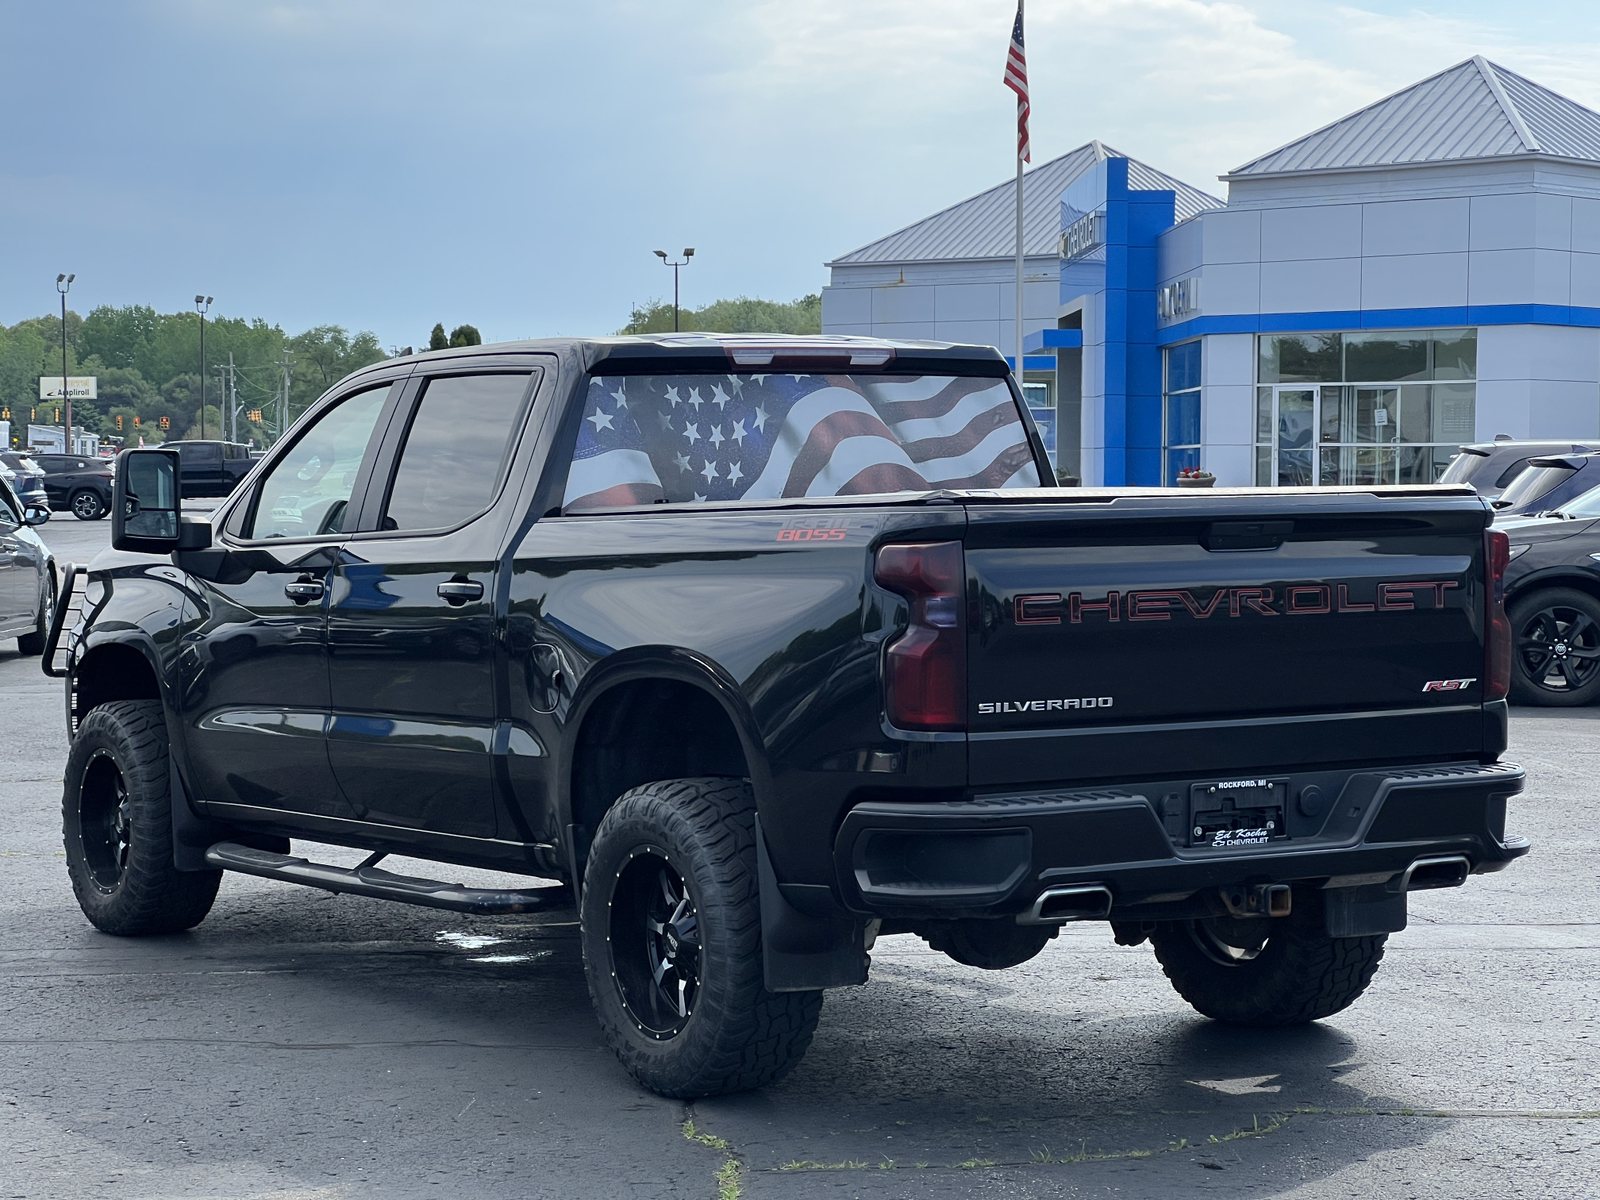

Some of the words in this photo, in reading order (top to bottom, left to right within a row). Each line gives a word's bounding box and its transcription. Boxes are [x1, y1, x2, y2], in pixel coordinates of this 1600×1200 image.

[776, 528, 848, 541] BOSS
[1013, 580, 1459, 626] CHEVROLET
[1421, 677, 1477, 692] RST
[978, 696, 1114, 714] SILVERADO
[1218, 780, 1257, 789] ROCKFORD,
[1257, 779, 1267, 787] MI
[1215, 830, 1232, 840] Ed
[1226, 837, 1269, 846] CHEVROLET
